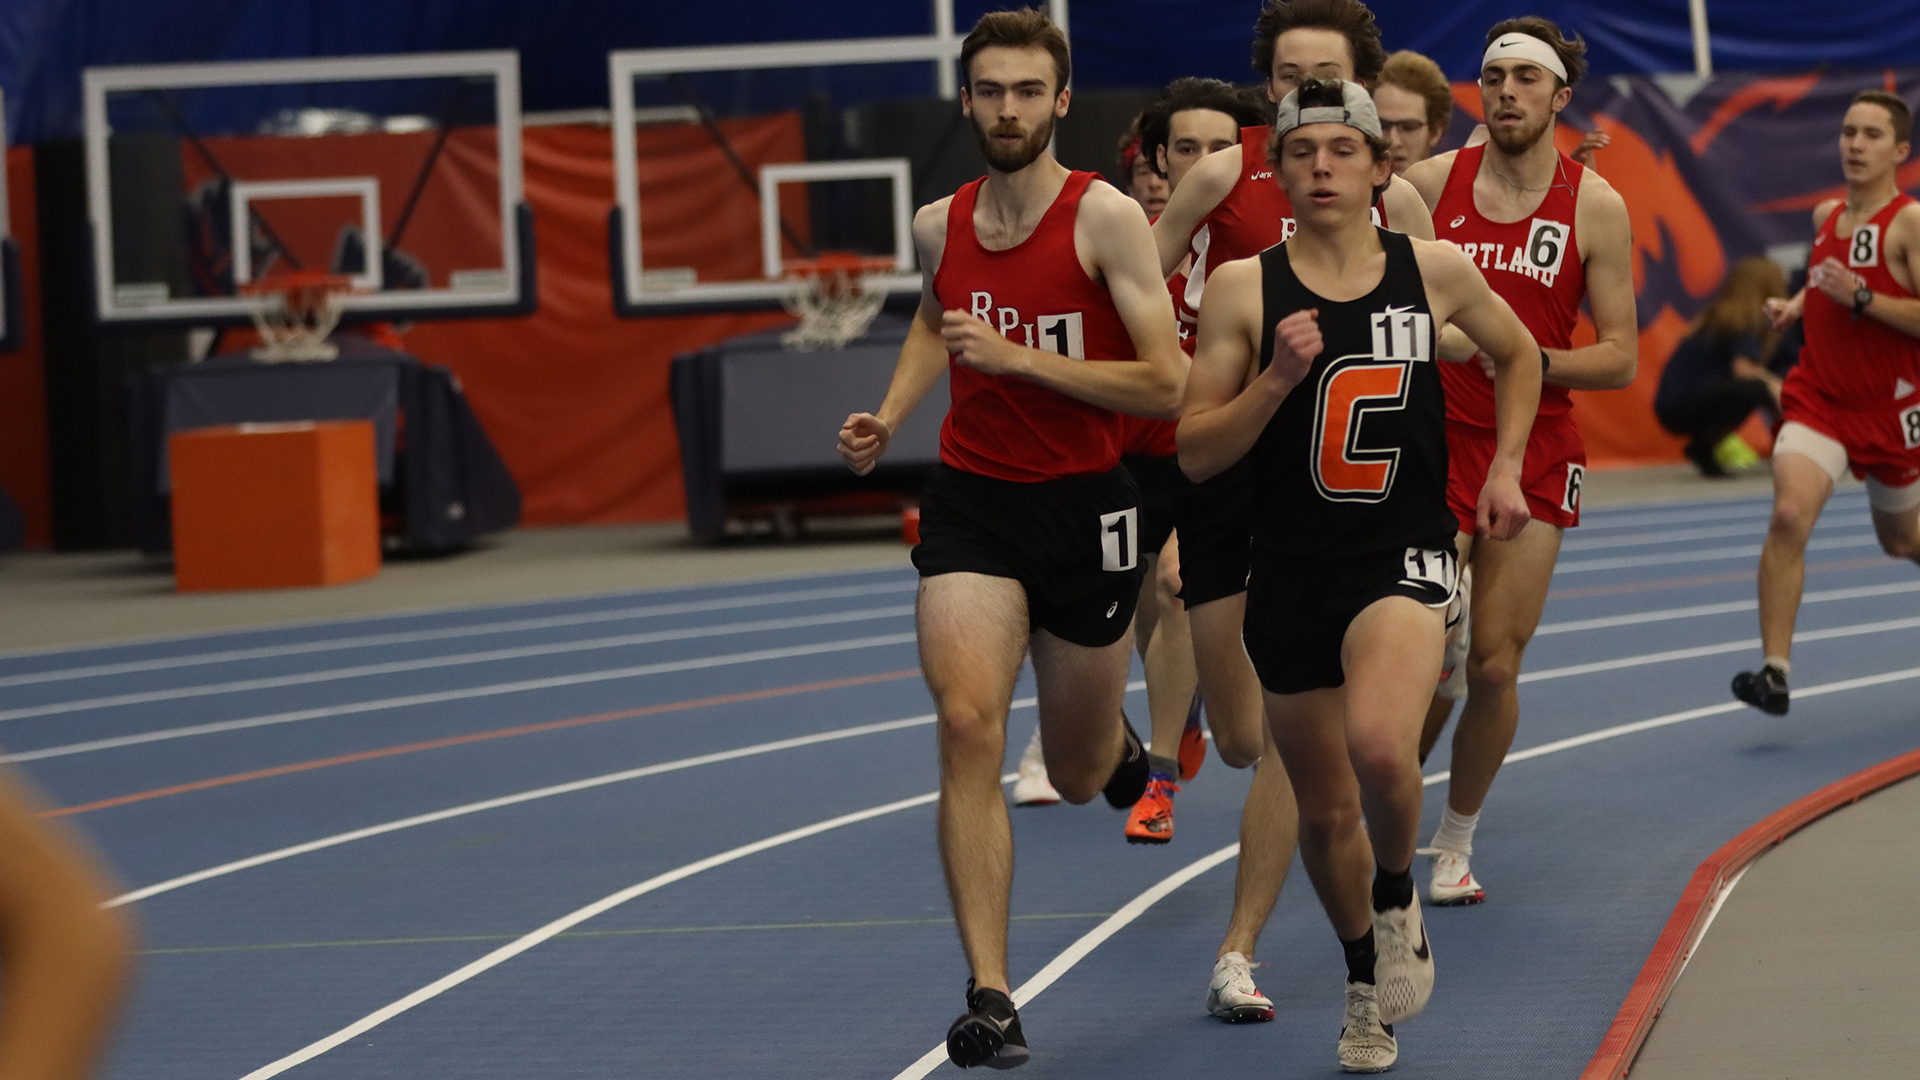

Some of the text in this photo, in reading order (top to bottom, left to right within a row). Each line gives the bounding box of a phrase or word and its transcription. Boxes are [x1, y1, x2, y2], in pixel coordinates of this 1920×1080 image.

[1529, 225, 1561, 268] 6
[1853, 229, 1872, 262] 8
[971, 291, 1035, 350] RPI
[1045, 319, 1069, 358] 1
[1376, 315, 1417, 358] 11
[1310, 354, 1413, 503] C
[1906, 411, 1920, 443] 8
[1568, 468, 1582, 511] 6
[1107, 515, 1129, 567] 1
[1408, 550, 1447, 586] 11
